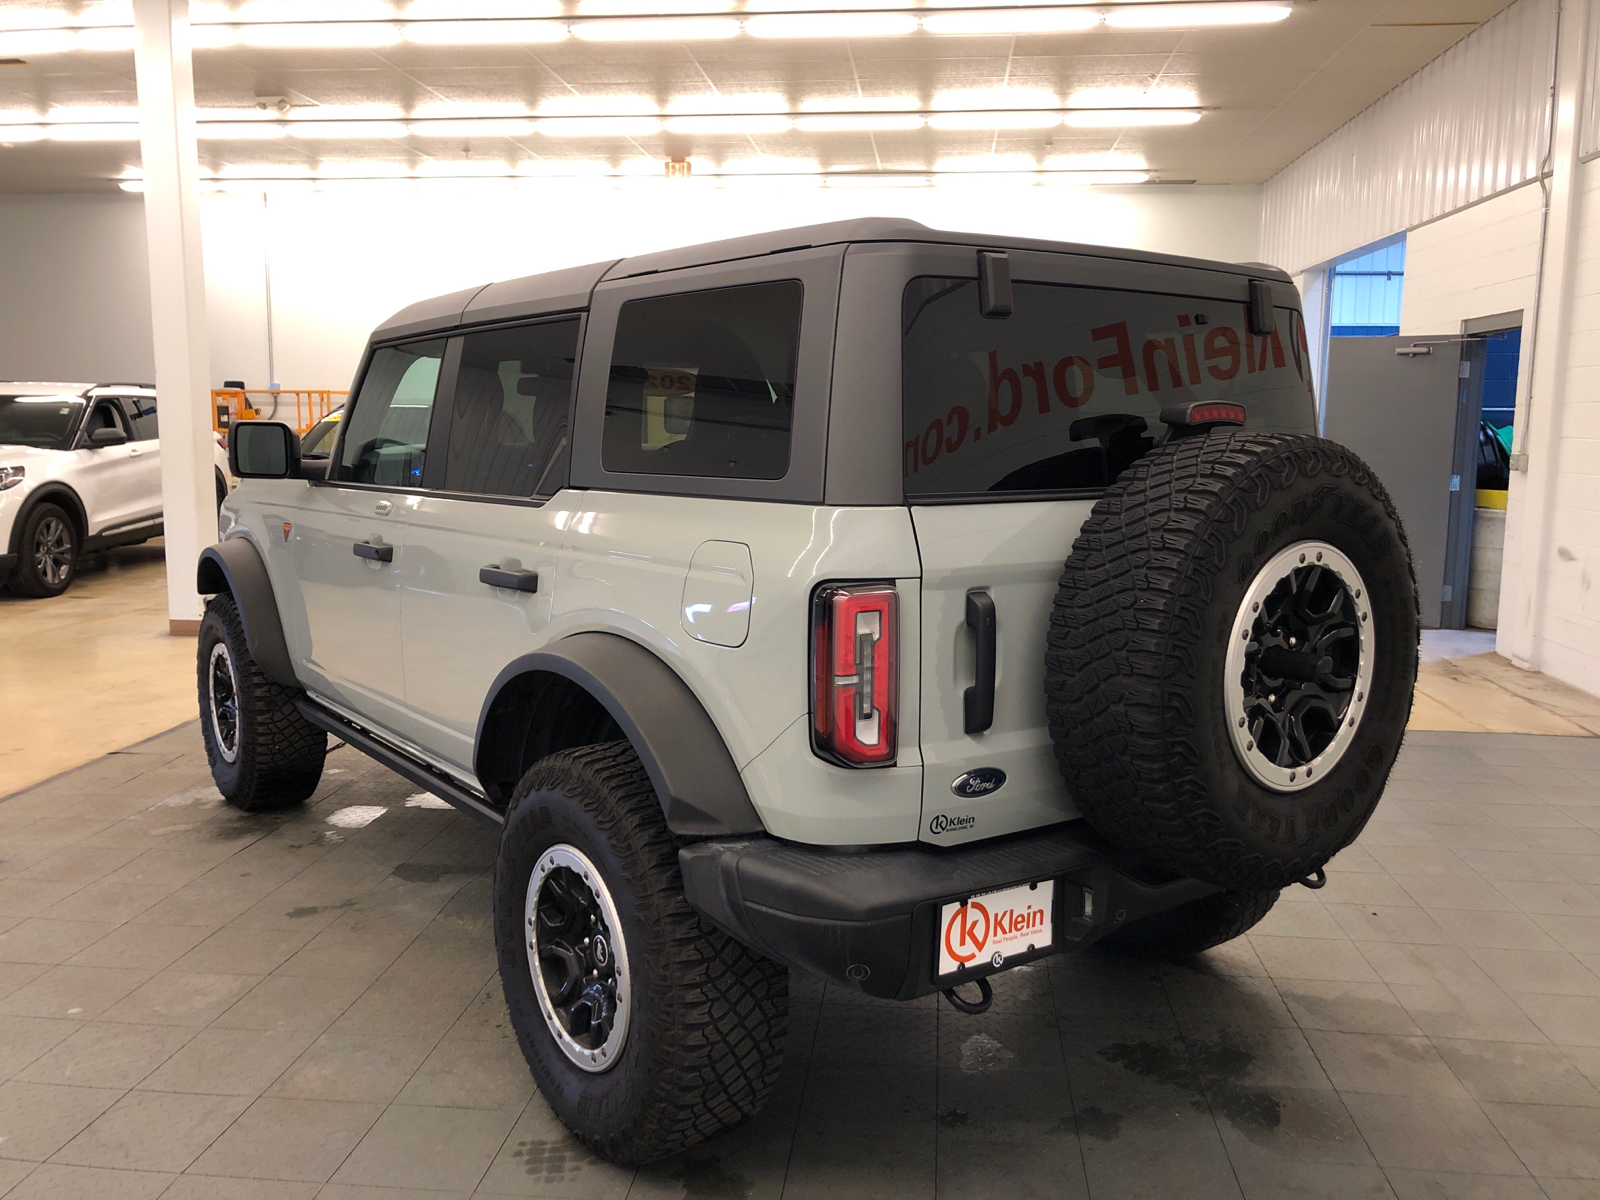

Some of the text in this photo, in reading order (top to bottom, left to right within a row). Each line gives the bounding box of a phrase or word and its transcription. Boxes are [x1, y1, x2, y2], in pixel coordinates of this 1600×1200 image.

[966, 777, 995, 794] Ford
[949, 815, 975, 827] Klein
[993, 904, 1044, 937] Klein
